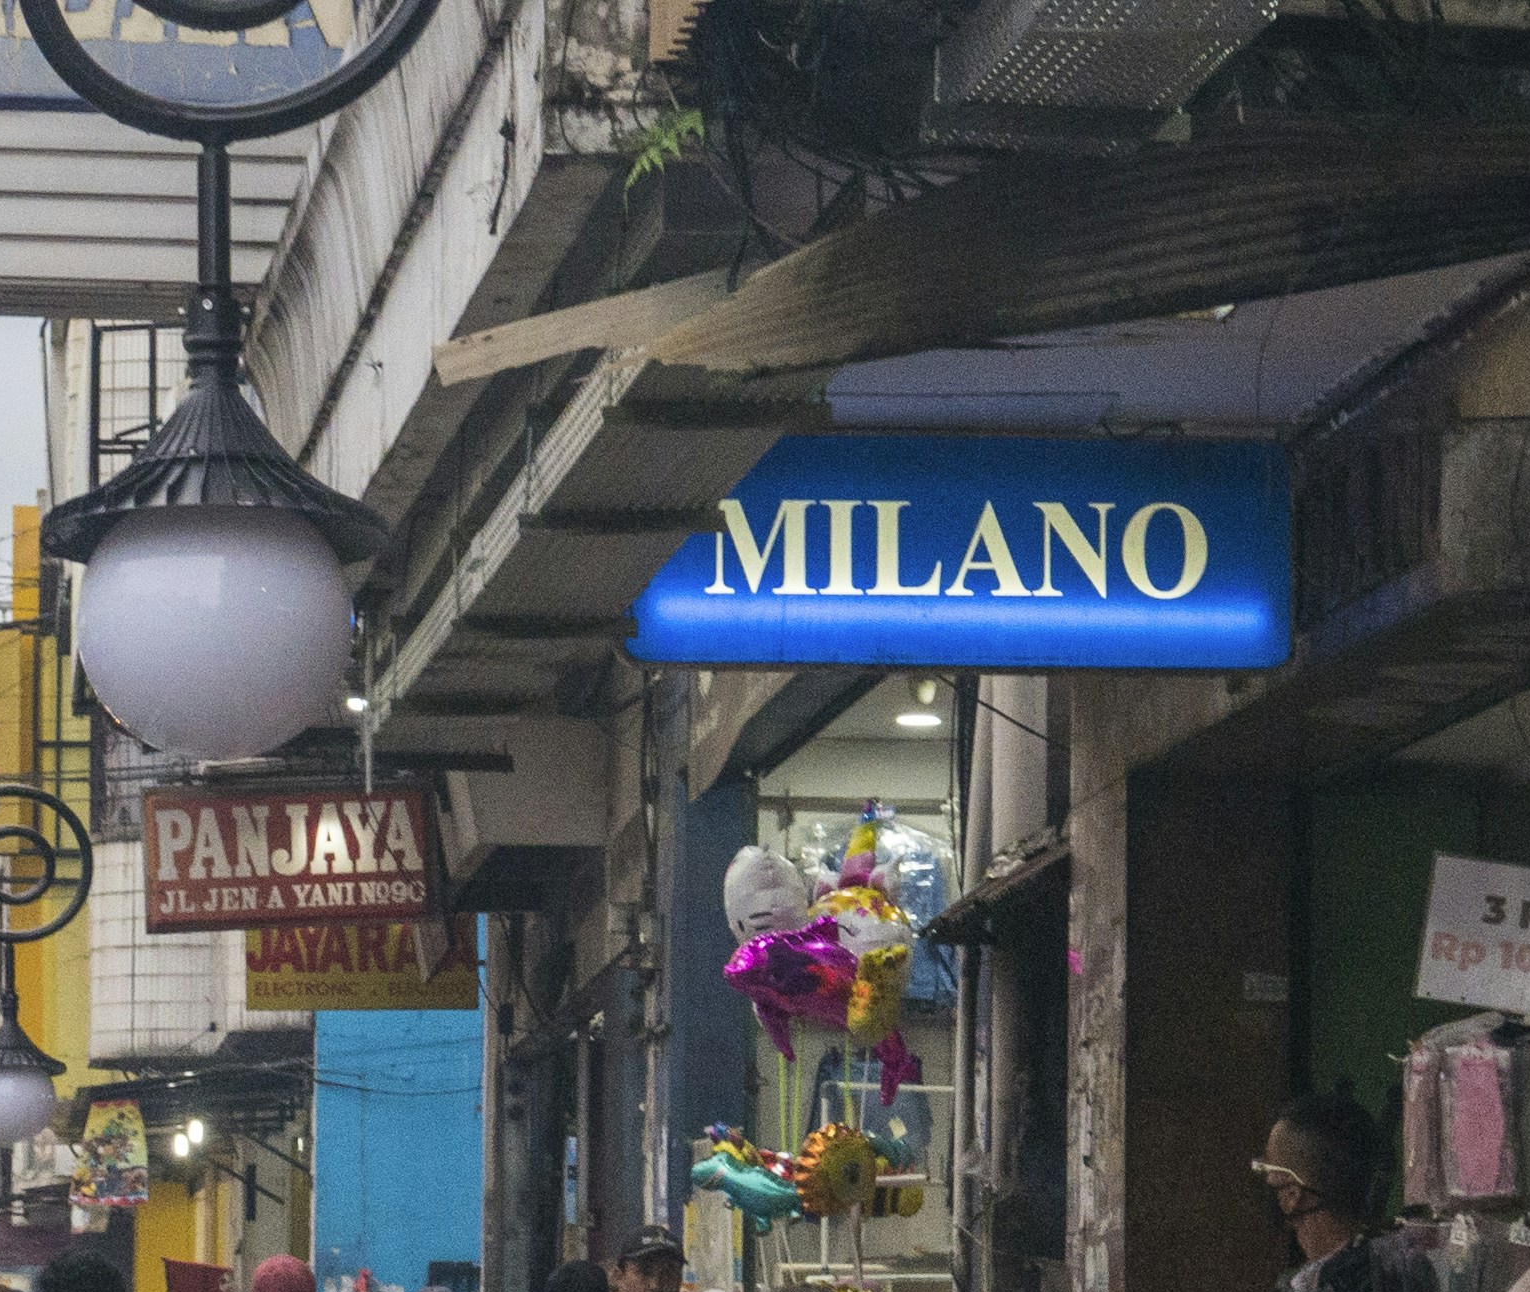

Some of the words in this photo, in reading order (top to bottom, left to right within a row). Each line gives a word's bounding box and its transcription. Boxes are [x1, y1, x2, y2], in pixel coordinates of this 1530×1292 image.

[704, 499, 1209, 599] MILANO
[155, 800, 424, 882] PANJAYA
[292, 880, 356, 907] YANI
[1481, 895, 1507, 925] 3
[1430, 931, 1487, 972] Rp
